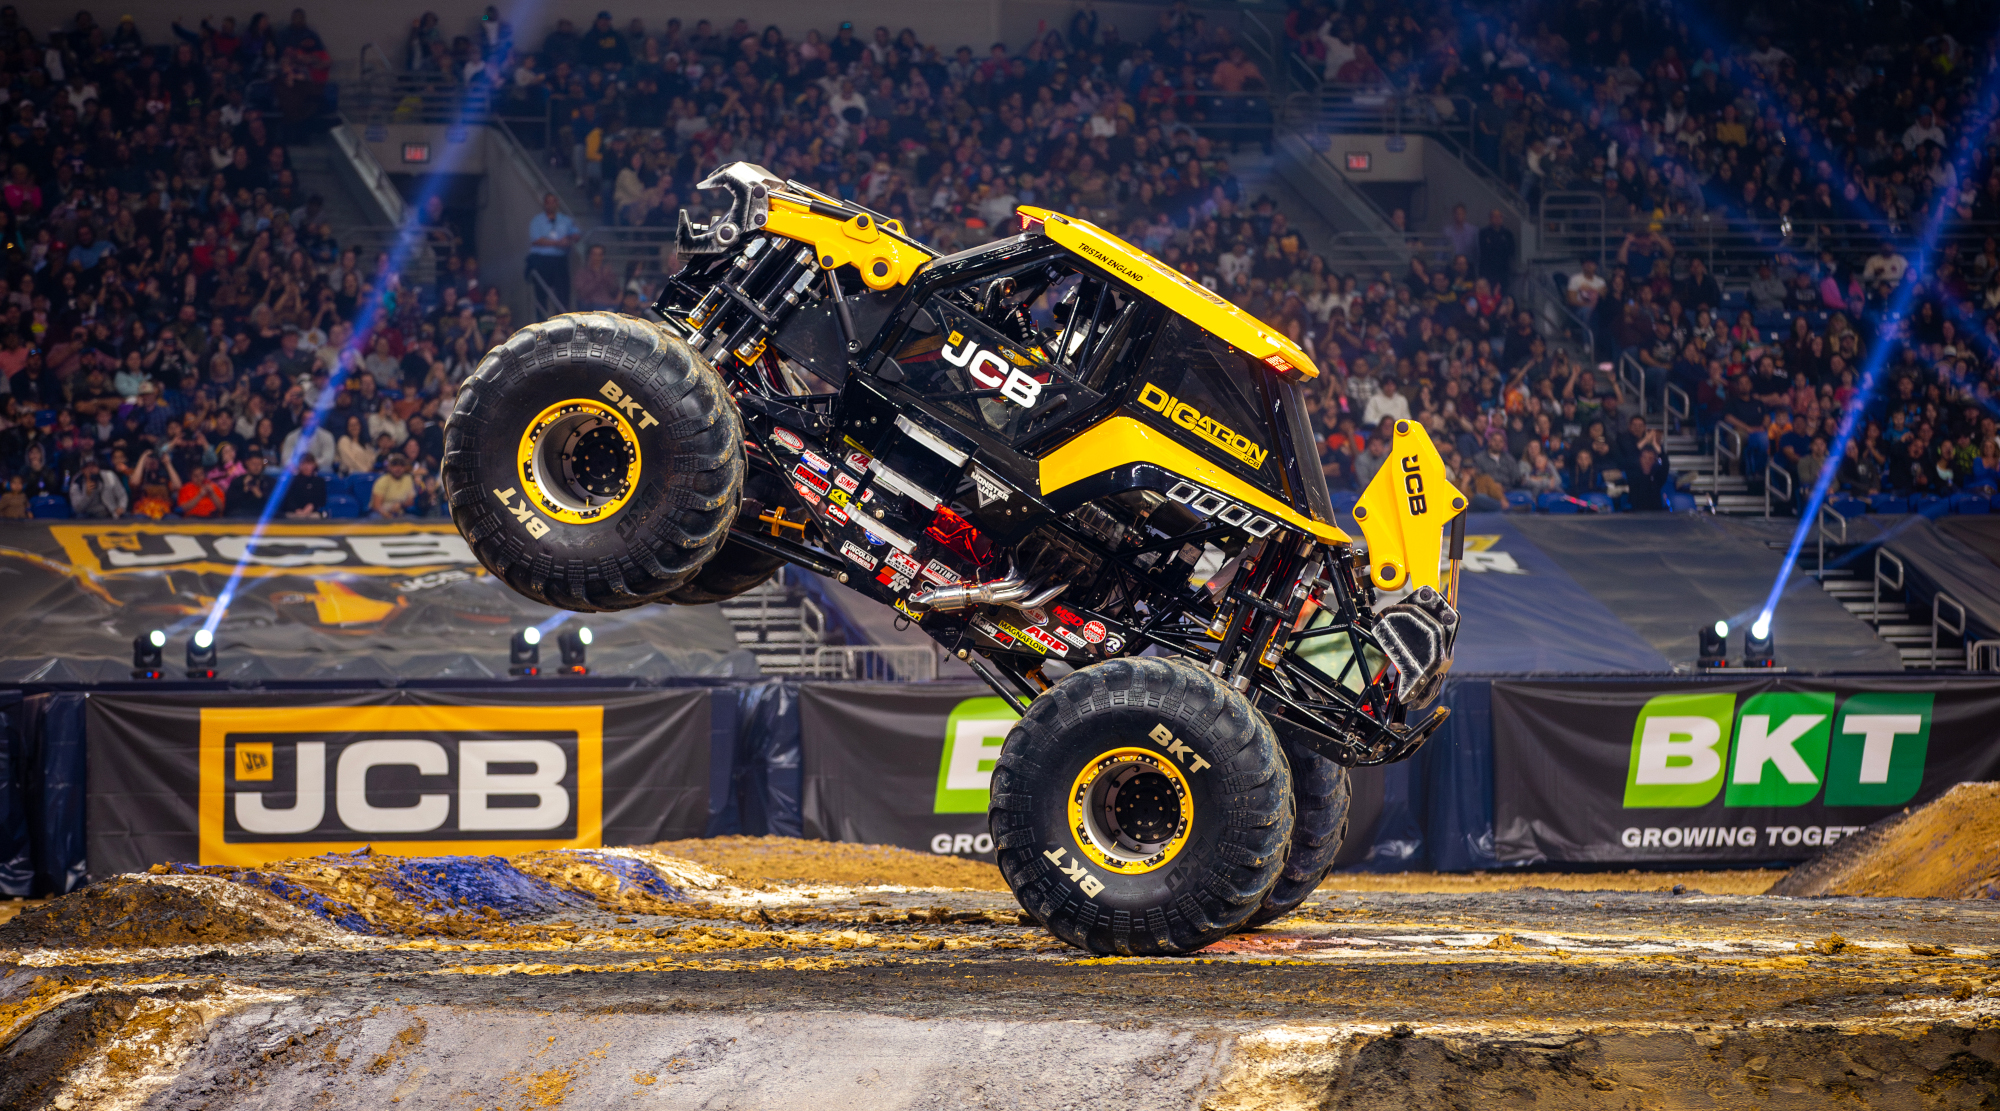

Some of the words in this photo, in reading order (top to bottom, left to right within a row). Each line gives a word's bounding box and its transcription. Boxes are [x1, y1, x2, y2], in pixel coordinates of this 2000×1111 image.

[1078, 243, 1109, 263] TRISTAN
[1107, 256, 1144, 282] ENGLAND
[941, 340, 1042, 409] JCB
[599, 379, 660, 430] BKT
[1137, 382, 1269, 464] DIGATRON
[1242, 455, 1260, 468] JCB
[795, 465, 830, 491] DERALE
[838, 476, 871, 499] SIMPN
[970, 471, 1010, 502] MONSTER
[978, 486, 997, 501] JAM
[1400, 454, 1428, 516] JCB
[493, 487, 551, 541] BKT
[828, 504, 848, 522] Coan
[107, 532, 479, 567] JCB
[844, 542, 873, 562] LINCOLN
[929, 561, 958, 582] OPTIMA
[972, 615, 998, 637] Holley
[1052, 605, 1084, 626] MSD
[1088, 624, 1103, 636] NGK
[999, 620, 1047, 653] MAGNAFLOW
[1025, 626, 1068, 651] ARP
[1148, 723, 1212, 774] BKT
[1634, 714, 1922, 785] BKT
[234, 739, 570, 833] JCB
[1621, 827, 1757, 848] GROWING
[1765, 826, 1867, 848] TOGET
[1043, 846, 1106, 899] BKT
